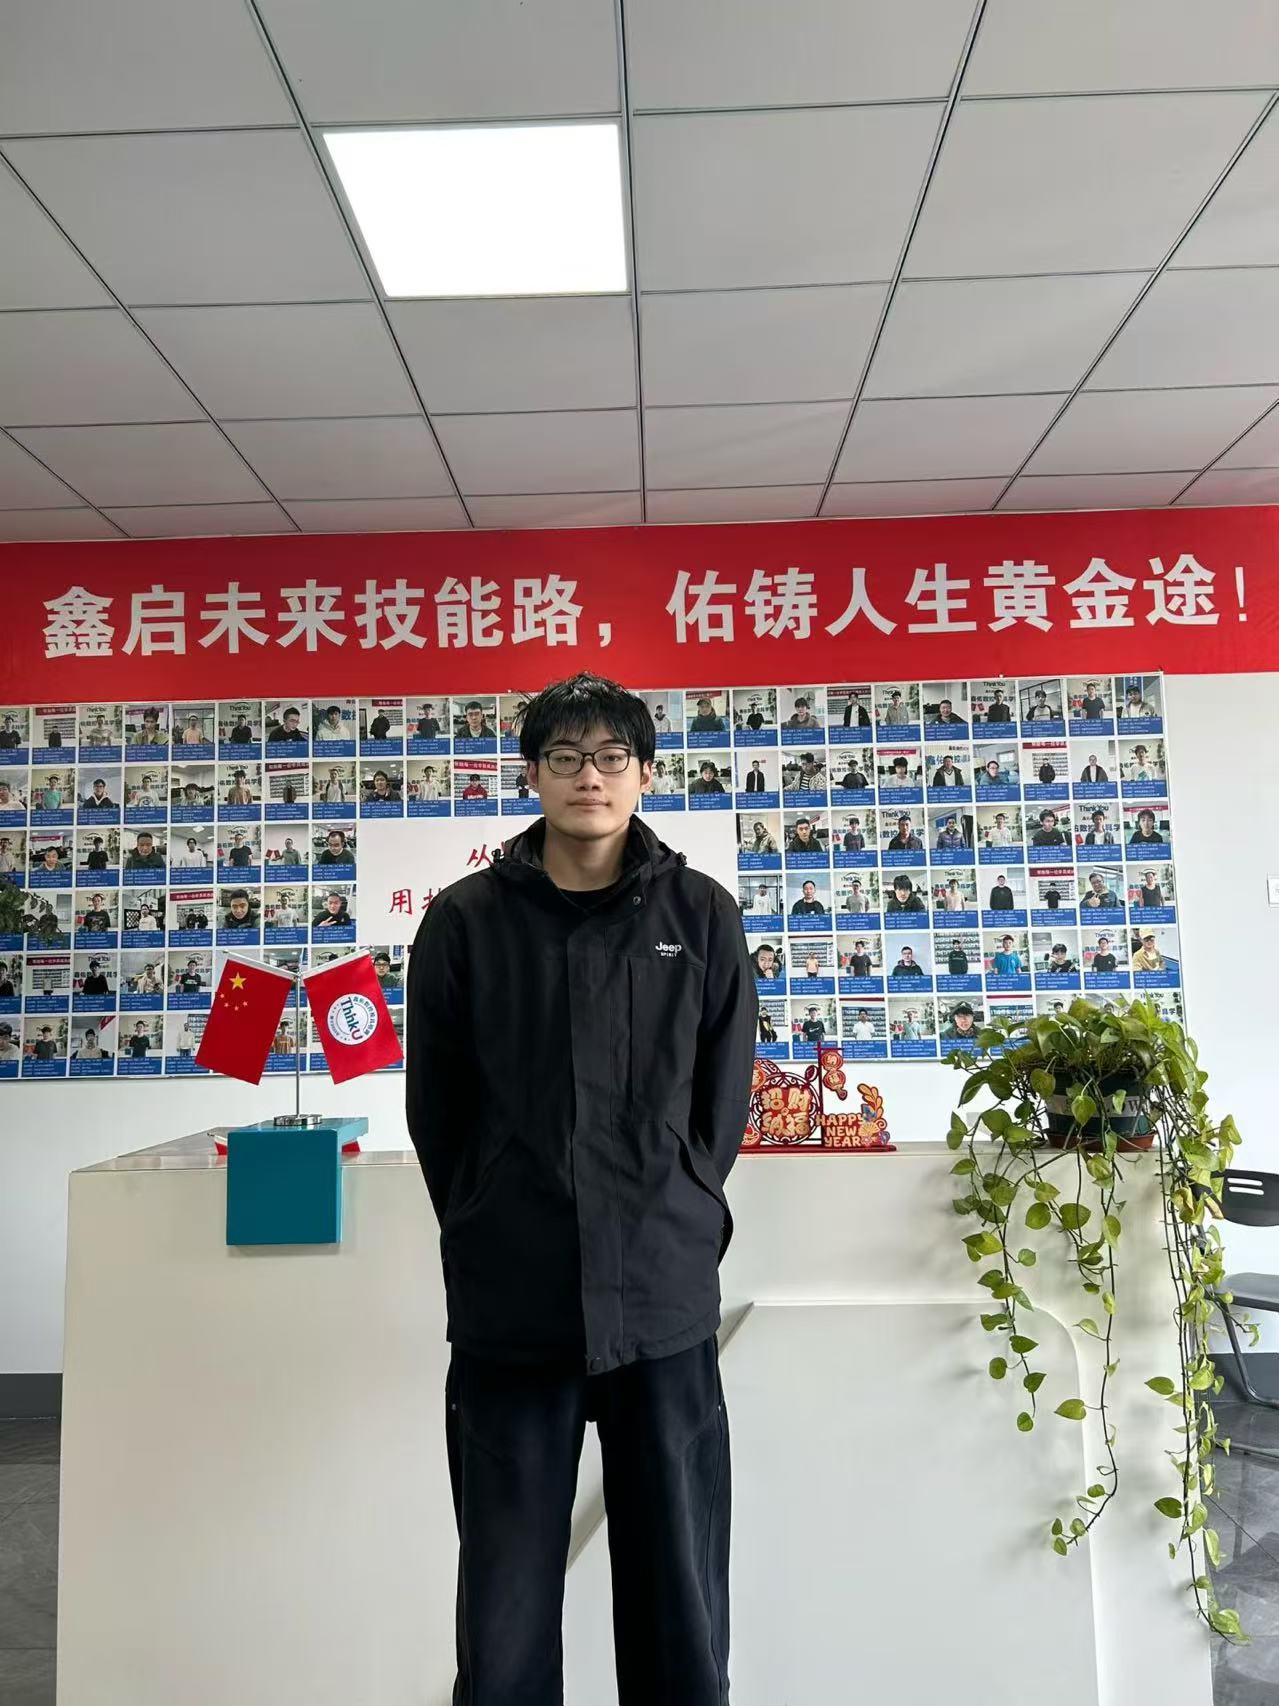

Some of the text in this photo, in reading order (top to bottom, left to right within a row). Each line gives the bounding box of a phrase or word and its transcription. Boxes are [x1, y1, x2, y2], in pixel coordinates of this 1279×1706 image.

[43, 554, 1247, 658] 鑫启未来技能路， 佑铸人生黄金途！
[655, 941, 682, 953] Jeep
[815, 1114, 863, 1126] HAPPY
[826, 1126, 857, 1136] NEW
[824, 1136, 862, 1147] YEAR
